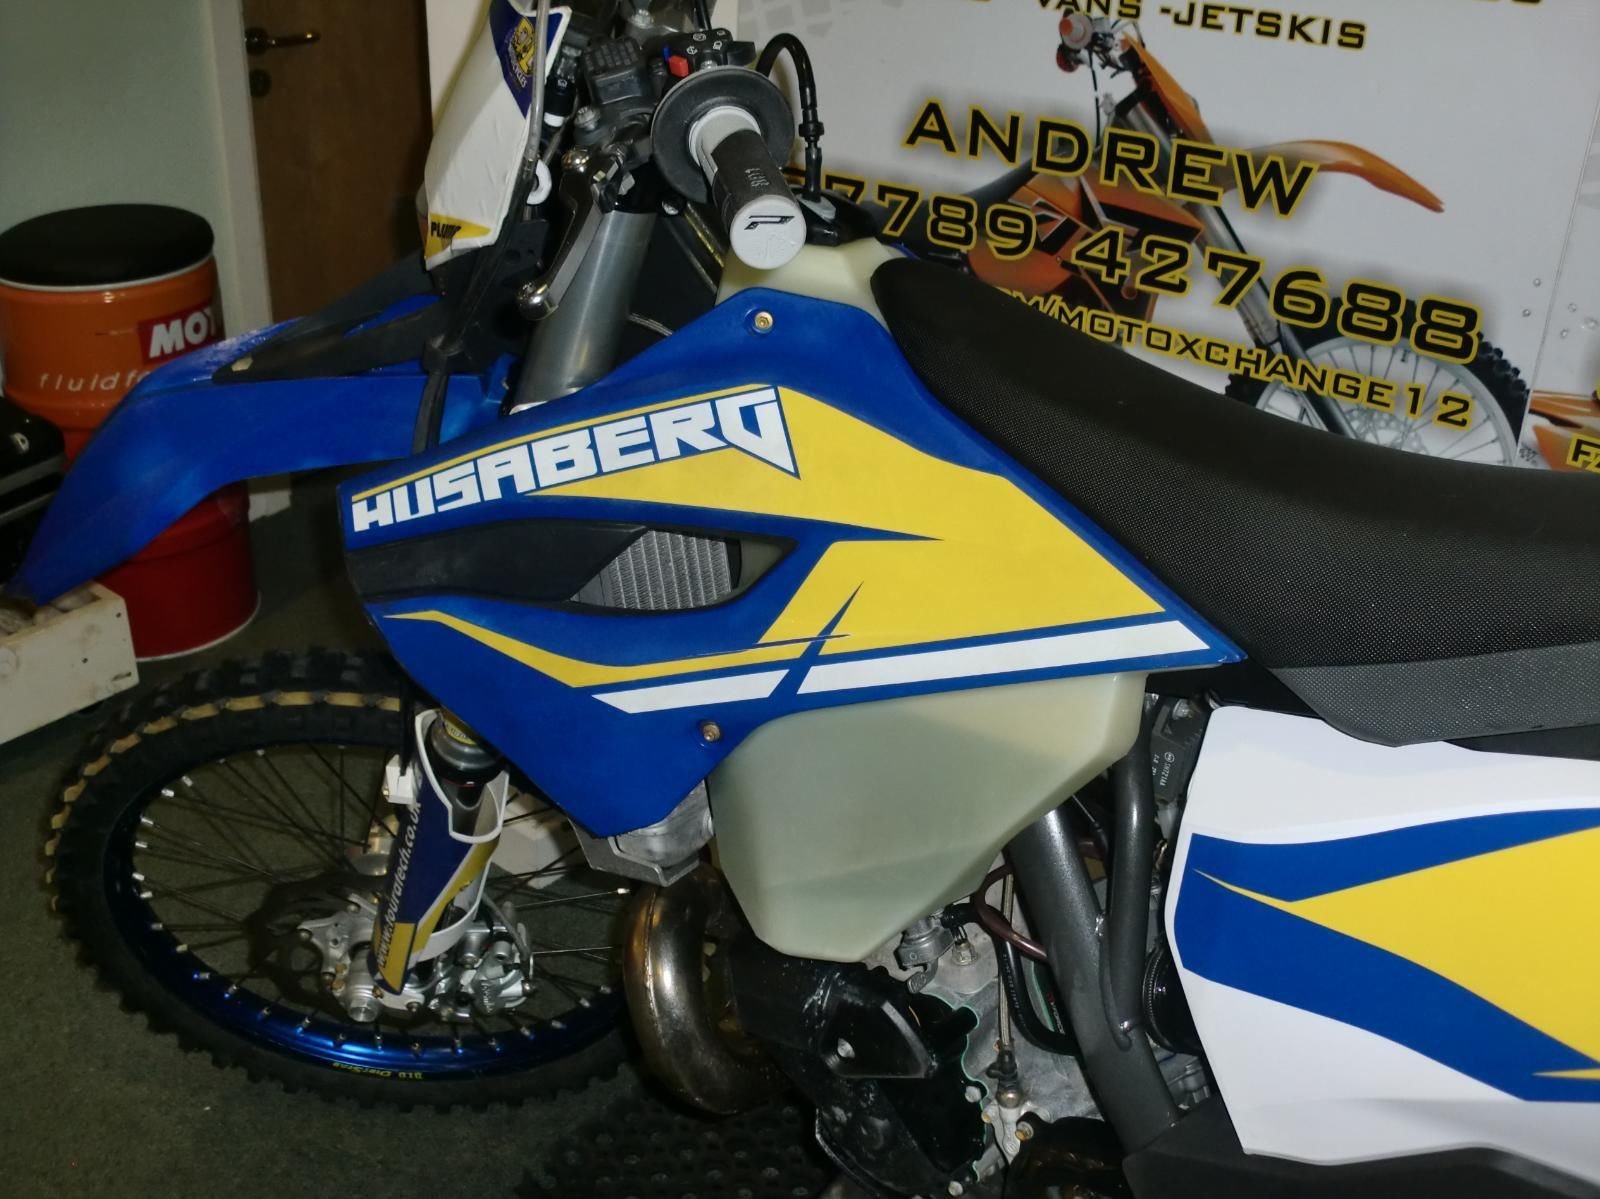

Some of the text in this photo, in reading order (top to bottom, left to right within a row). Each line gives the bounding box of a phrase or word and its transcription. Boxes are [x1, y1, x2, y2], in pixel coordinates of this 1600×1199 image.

[904, 98, 1319, 219] ANDREW
[1071, 226, 1484, 365] 427688
[352, 386, 796, 532] HUSABERG
